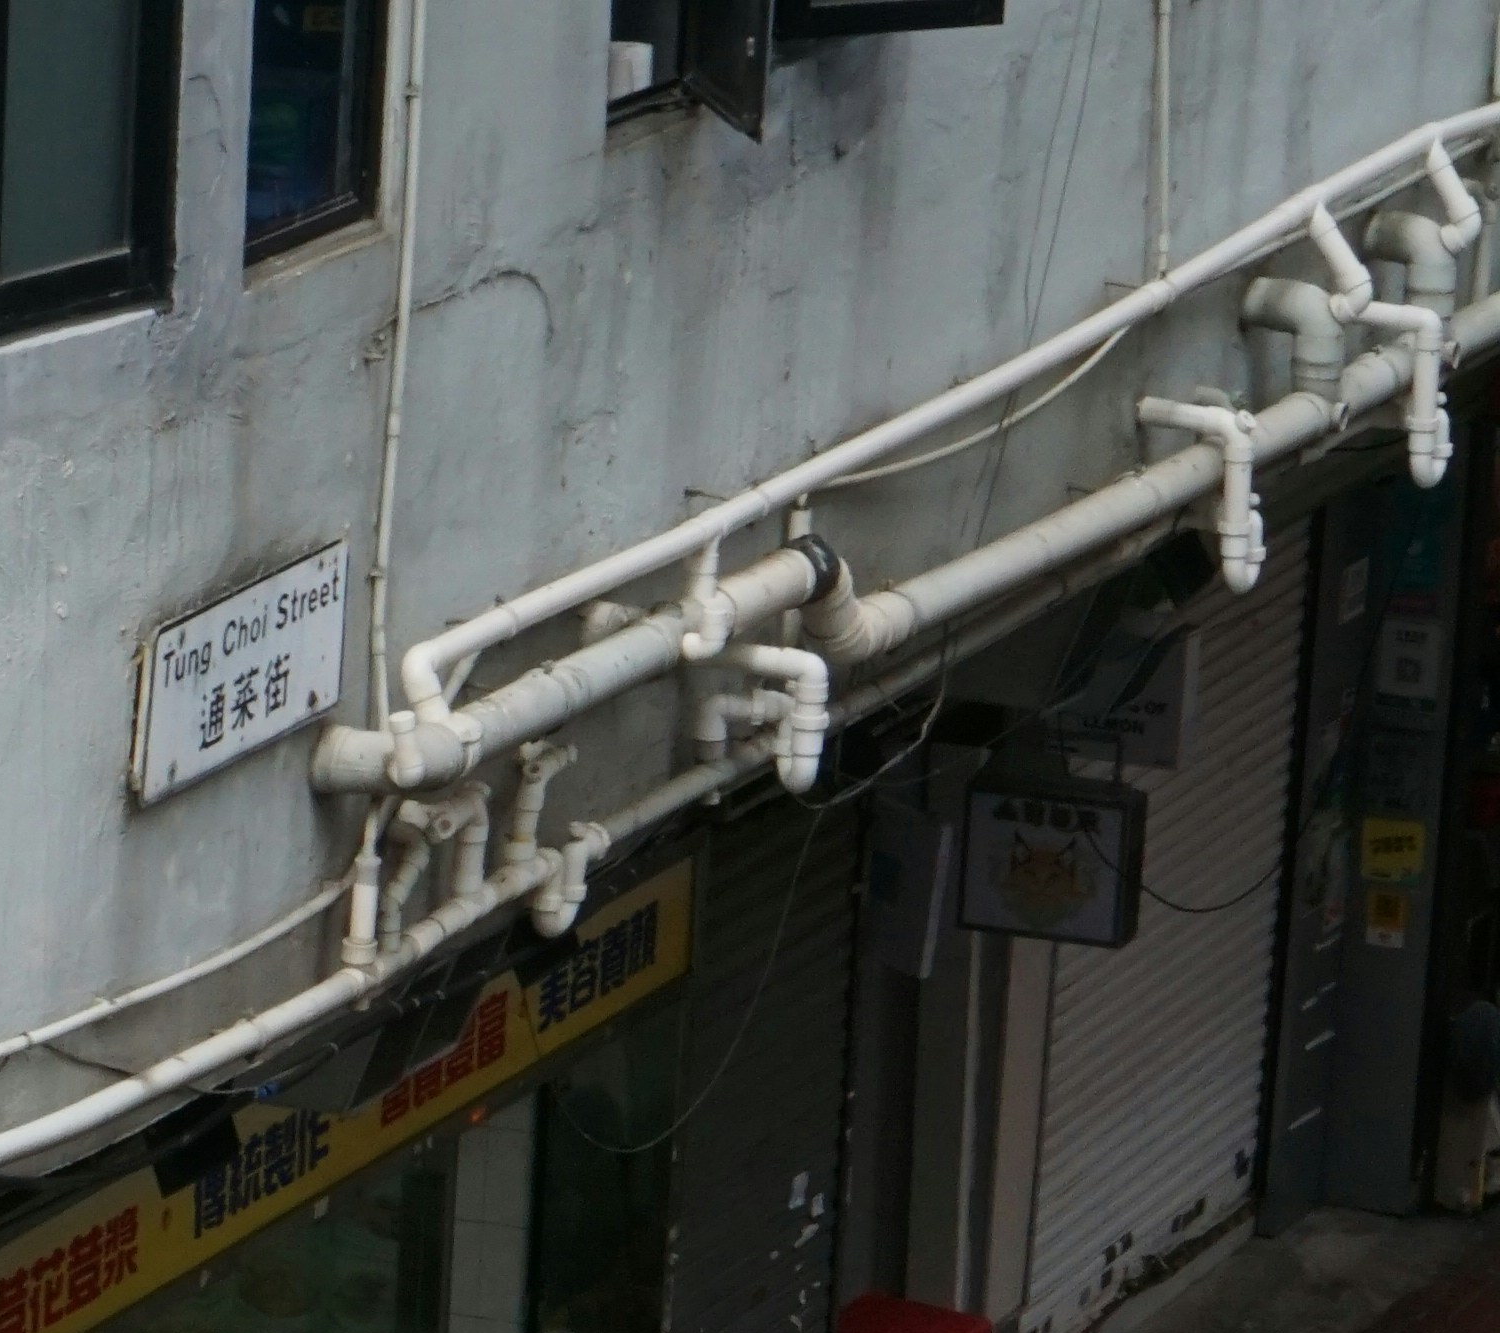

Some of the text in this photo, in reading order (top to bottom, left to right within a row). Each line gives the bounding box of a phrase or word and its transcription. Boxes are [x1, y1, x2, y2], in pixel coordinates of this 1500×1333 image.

[163, 568, 340, 689] Tung Choi Street
[199, 653, 291, 752] 通菜街
